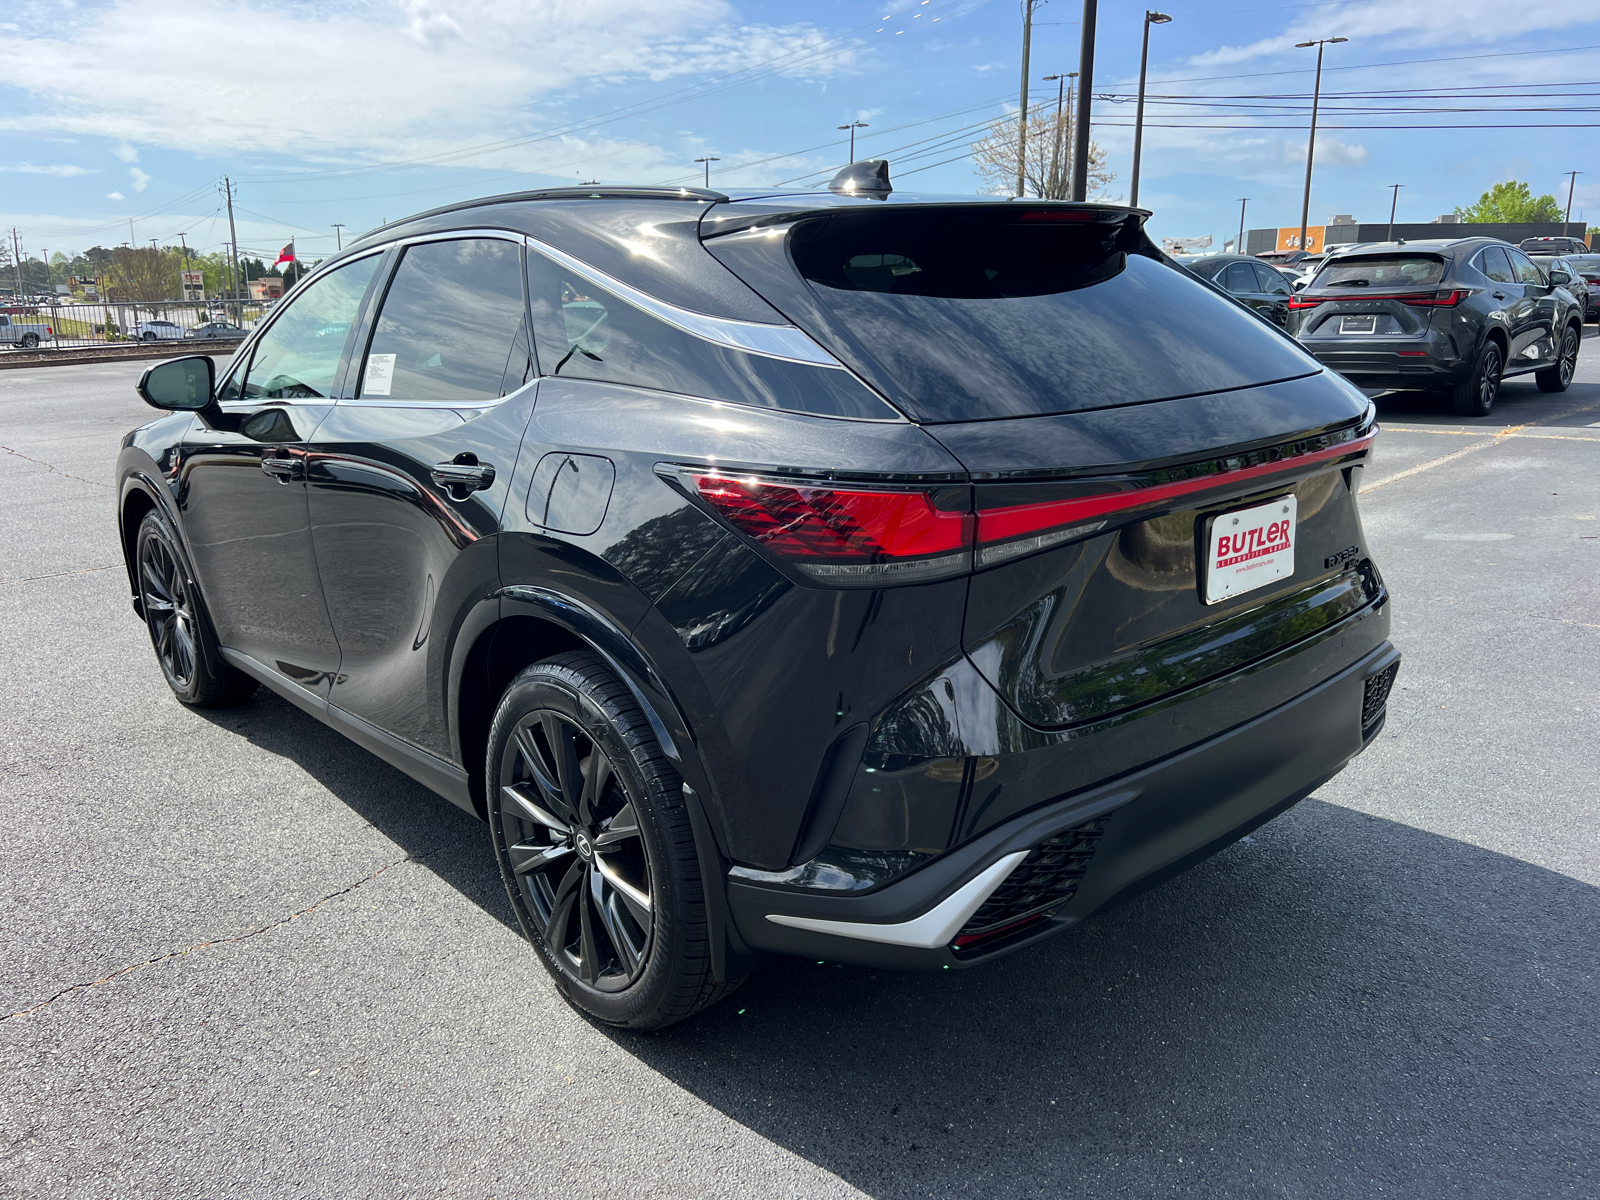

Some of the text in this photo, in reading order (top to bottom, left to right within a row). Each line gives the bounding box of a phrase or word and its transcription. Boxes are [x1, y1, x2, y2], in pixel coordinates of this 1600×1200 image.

[1285, 234, 1314, 249] Jep
[1216, 437, 1328, 472] LEXUS
[1217, 541, 1291, 568] AUTOMOTIVE GROUP
